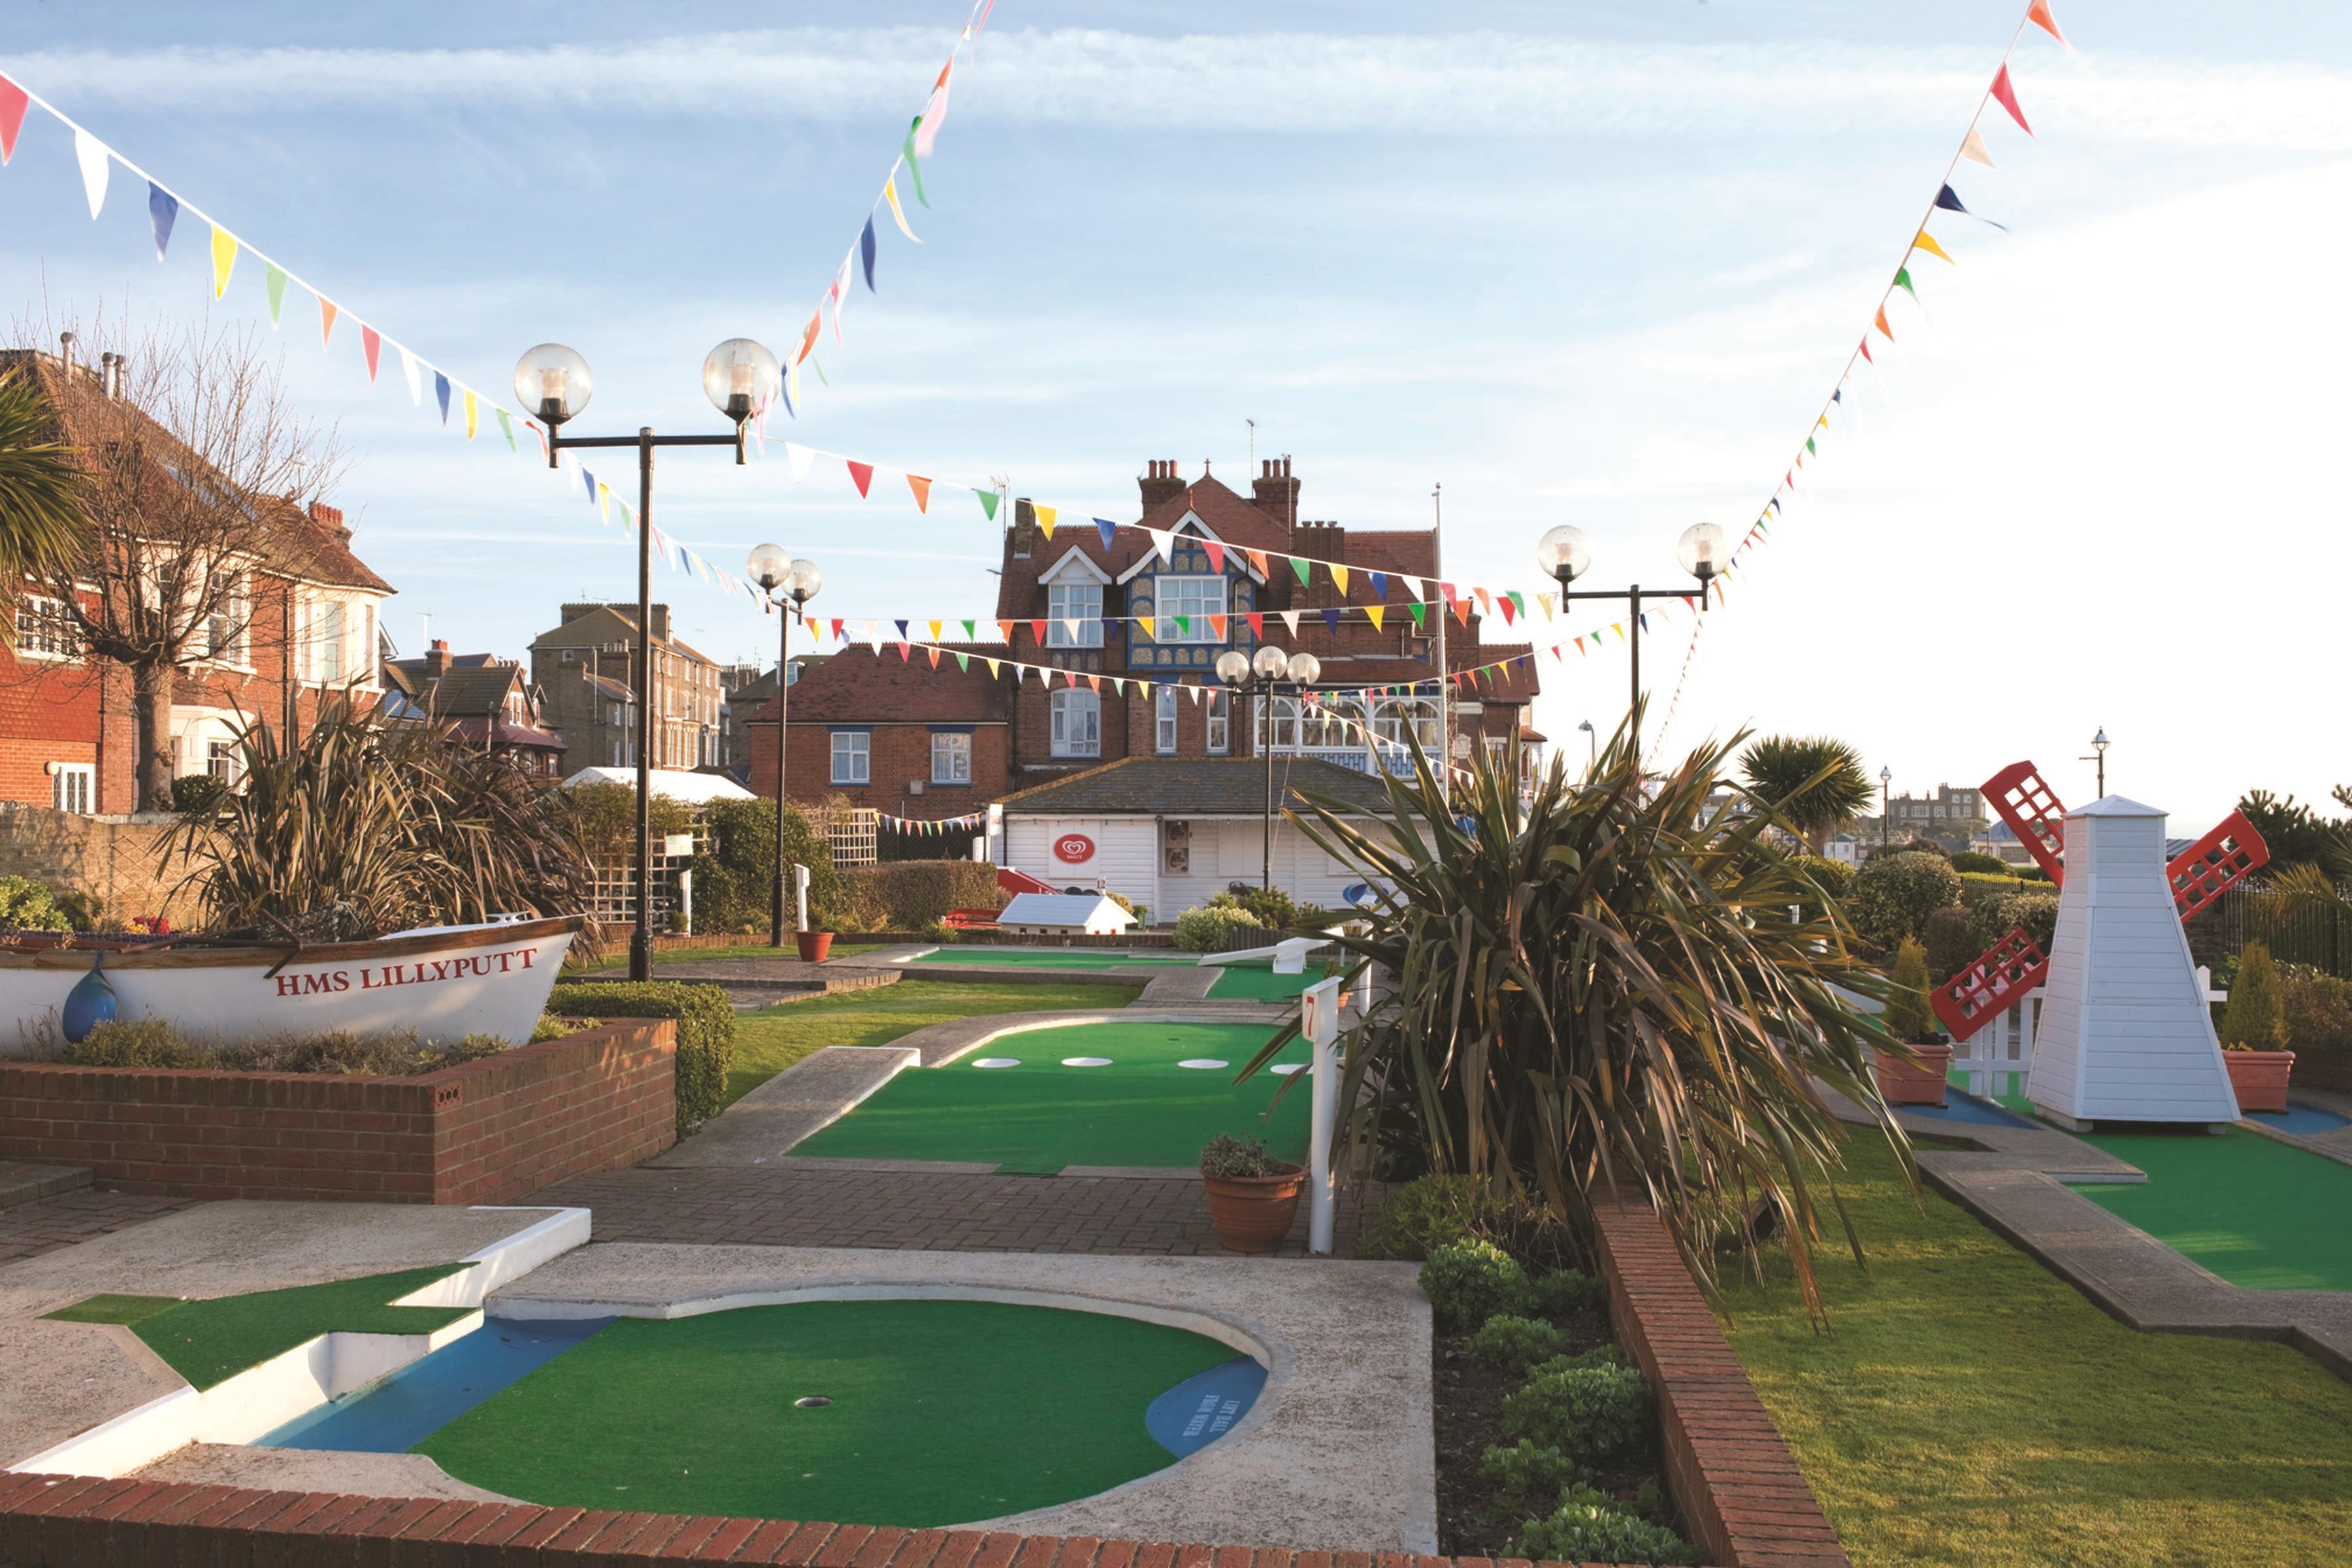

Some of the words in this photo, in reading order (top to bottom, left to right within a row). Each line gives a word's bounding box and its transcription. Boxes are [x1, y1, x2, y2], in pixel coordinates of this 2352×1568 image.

[276, 971, 350, 996] HMS
[360, 948, 538, 989] LILLYPUTT
[1307, 996, 1314, 1037] 7
[1183, 1414, 1209, 1436] WATER
[1209, 1416, 1232, 1432] BALL
